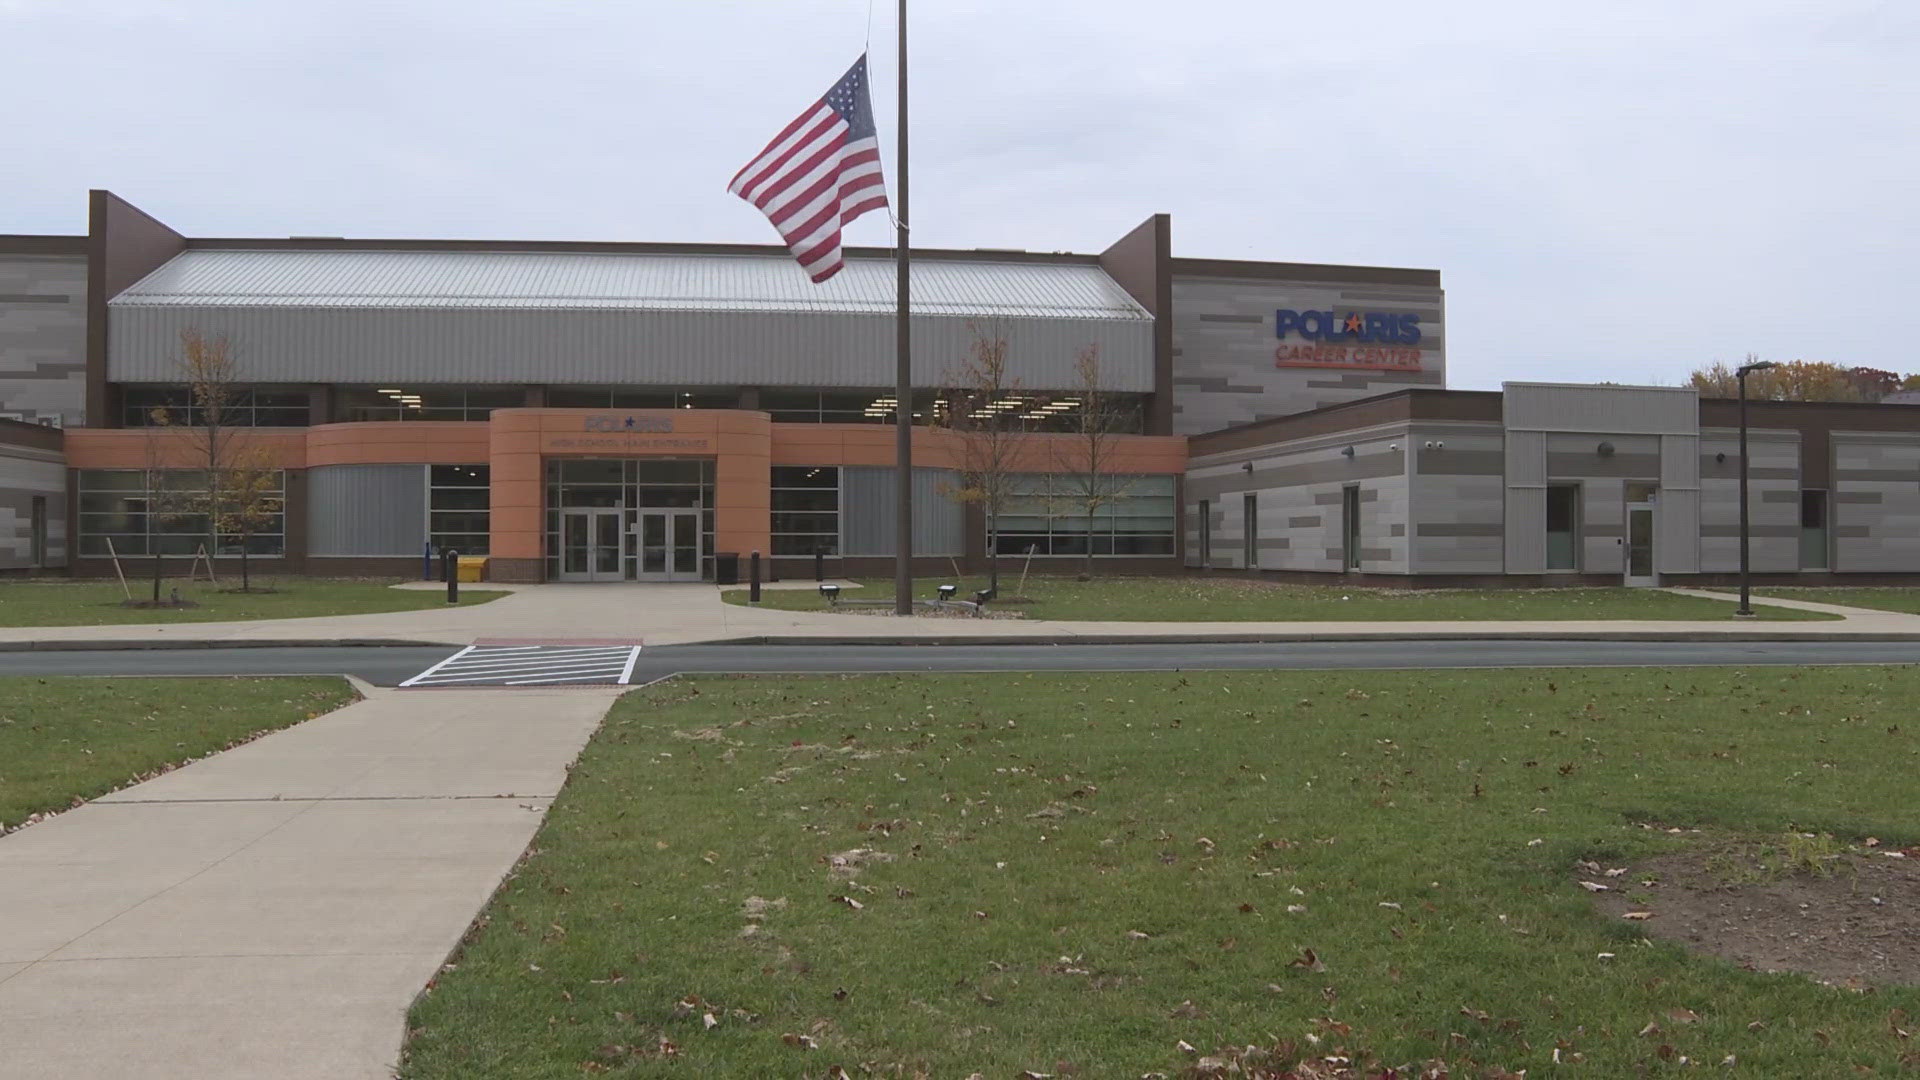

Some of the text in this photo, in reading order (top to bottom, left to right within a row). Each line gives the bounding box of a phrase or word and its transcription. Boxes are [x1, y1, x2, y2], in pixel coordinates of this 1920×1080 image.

[1276, 309, 1421, 344] POLARIS
[1276, 345, 1421, 365] CAREER CENTER
